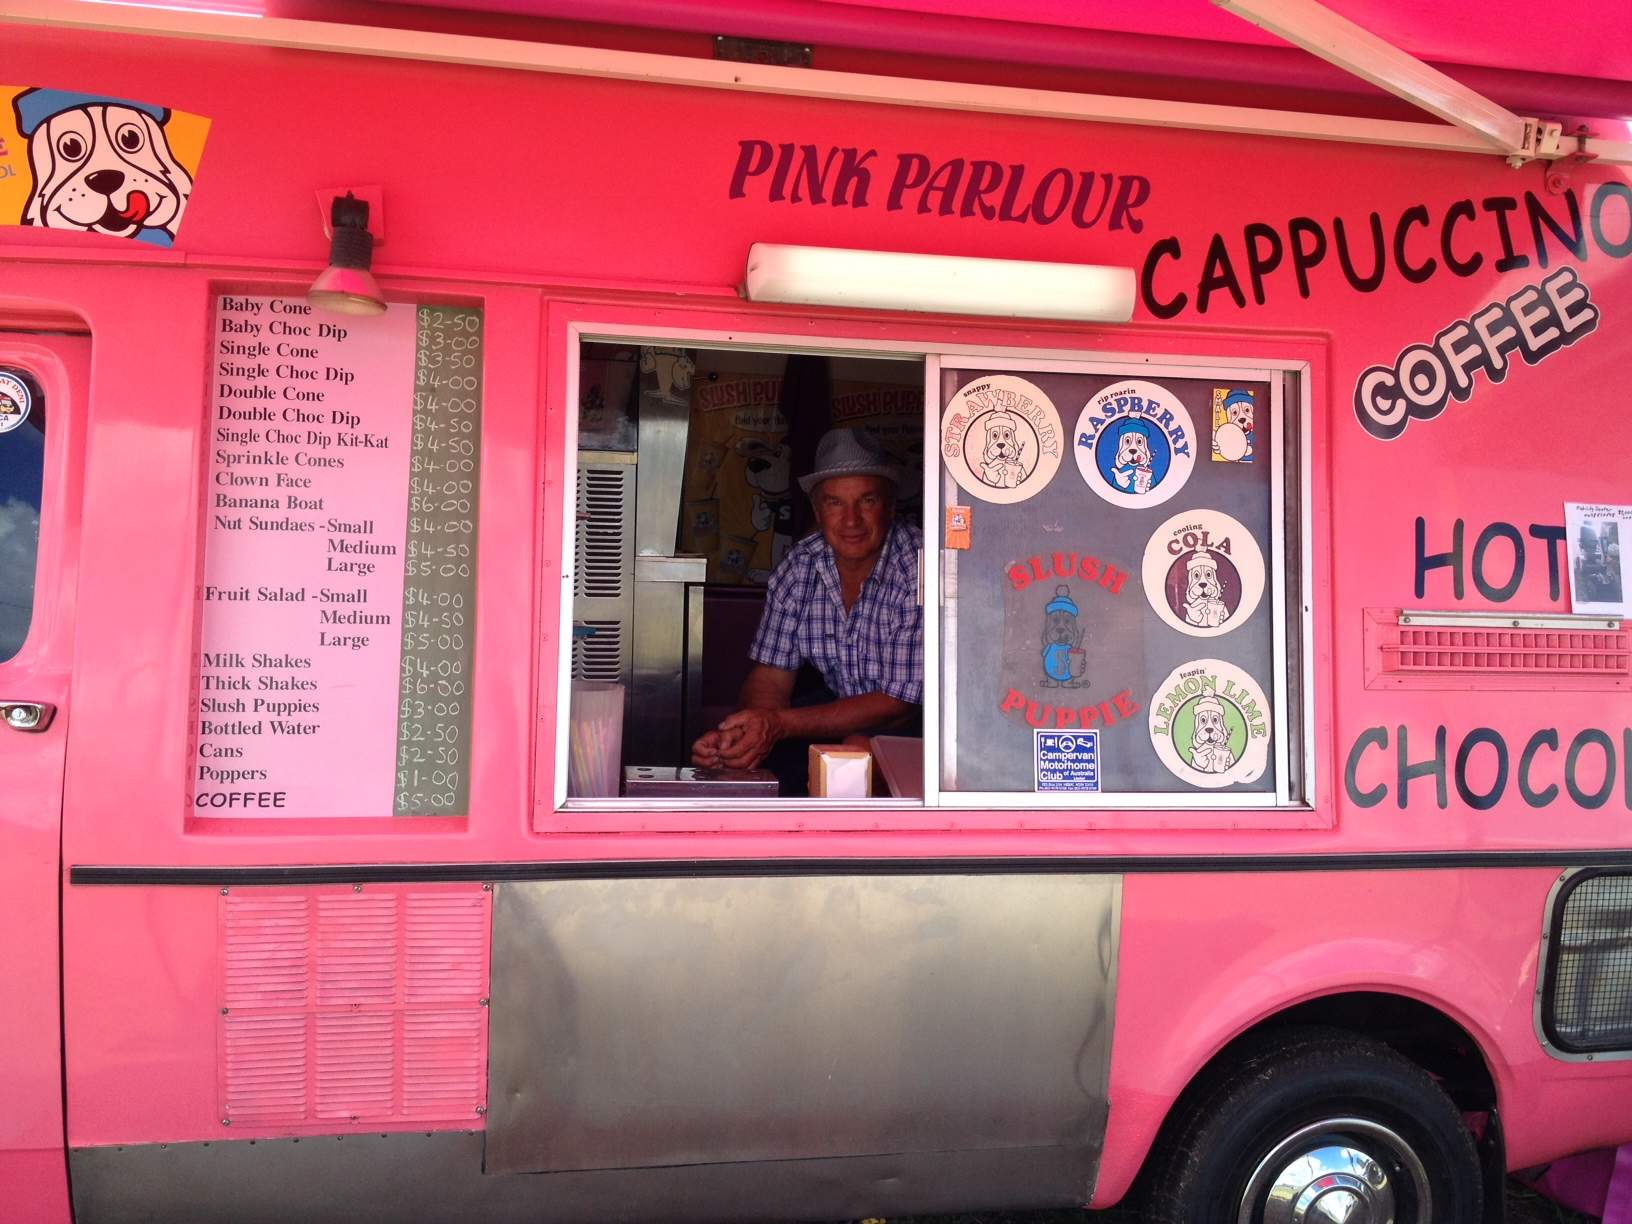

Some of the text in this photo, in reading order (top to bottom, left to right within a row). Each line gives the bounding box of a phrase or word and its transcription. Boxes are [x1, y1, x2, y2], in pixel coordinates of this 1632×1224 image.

[728, 139, 1151, 234] PINK PARLOUR
[1141, 181, 1632, 319] CAPPUCCINO
[222, 297, 312, 316] Baby Cone
[221, 318, 348, 342] Baby Choc Dip
[219, 340, 319, 359] Single Cone
[1355, 268, 1598, 438] COFFEE
[218, 361, 355, 385] Single Choc Dip
[218, 383, 325, 402] Double Cone
[700, 379, 784, 409] SLUSH PU
[963, 383, 991, 398] snappy
[1097, 394, 1109, 405] rip
[217, 405, 361, 429] Double Choc Dip
[944, 389, 1059, 458] STRAWBERRY
[1078, 396, 1190, 458] RASPBERRY
[216, 428, 389, 449] Single Choc Dip Kit-Kat
[215, 450, 345, 469] Sprinkle Cones
[215, 471, 312, 489] Clown Face
[215, 493, 324, 510] Banana Boat
[214, 515, 374, 534] Nut Sundaes -Small
[1173, 523, 1203, 536] cooling
[327, 539, 397, 555] Medium
[1167, 531, 1232, 555] COLA
[326, 558, 376, 575] Large
[1414, 516, 1567, 603] HOT
[1008, 552, 1129, 597] SLUSH
[205, 587, 368, 603] Fruit Salad -Small
[320, 610, 391, 625] Medium
[319, 632, 370, 650] Large
[203, 653, 311, 668] Milk Shakes
[202, 675, 318, 690] Thick Shakes
[200, 698, 320, 716] Slush Puppies
[1000, 687, 1141, 730] PUPPIE
[1154, 675, 1267, 739] LEMON LIME
[200, 720, 321, 735] Bottled Water
[199, 743, 243, 758] Cans
[1040, 751, 1094, 761] Campervan
[199, 765, 267, 784] Poppers
[1040, 760, 1095, 770] Motorhome
[1040, 771, 1063, 780] Club
[195, 791, 287, 808] COFFEE
